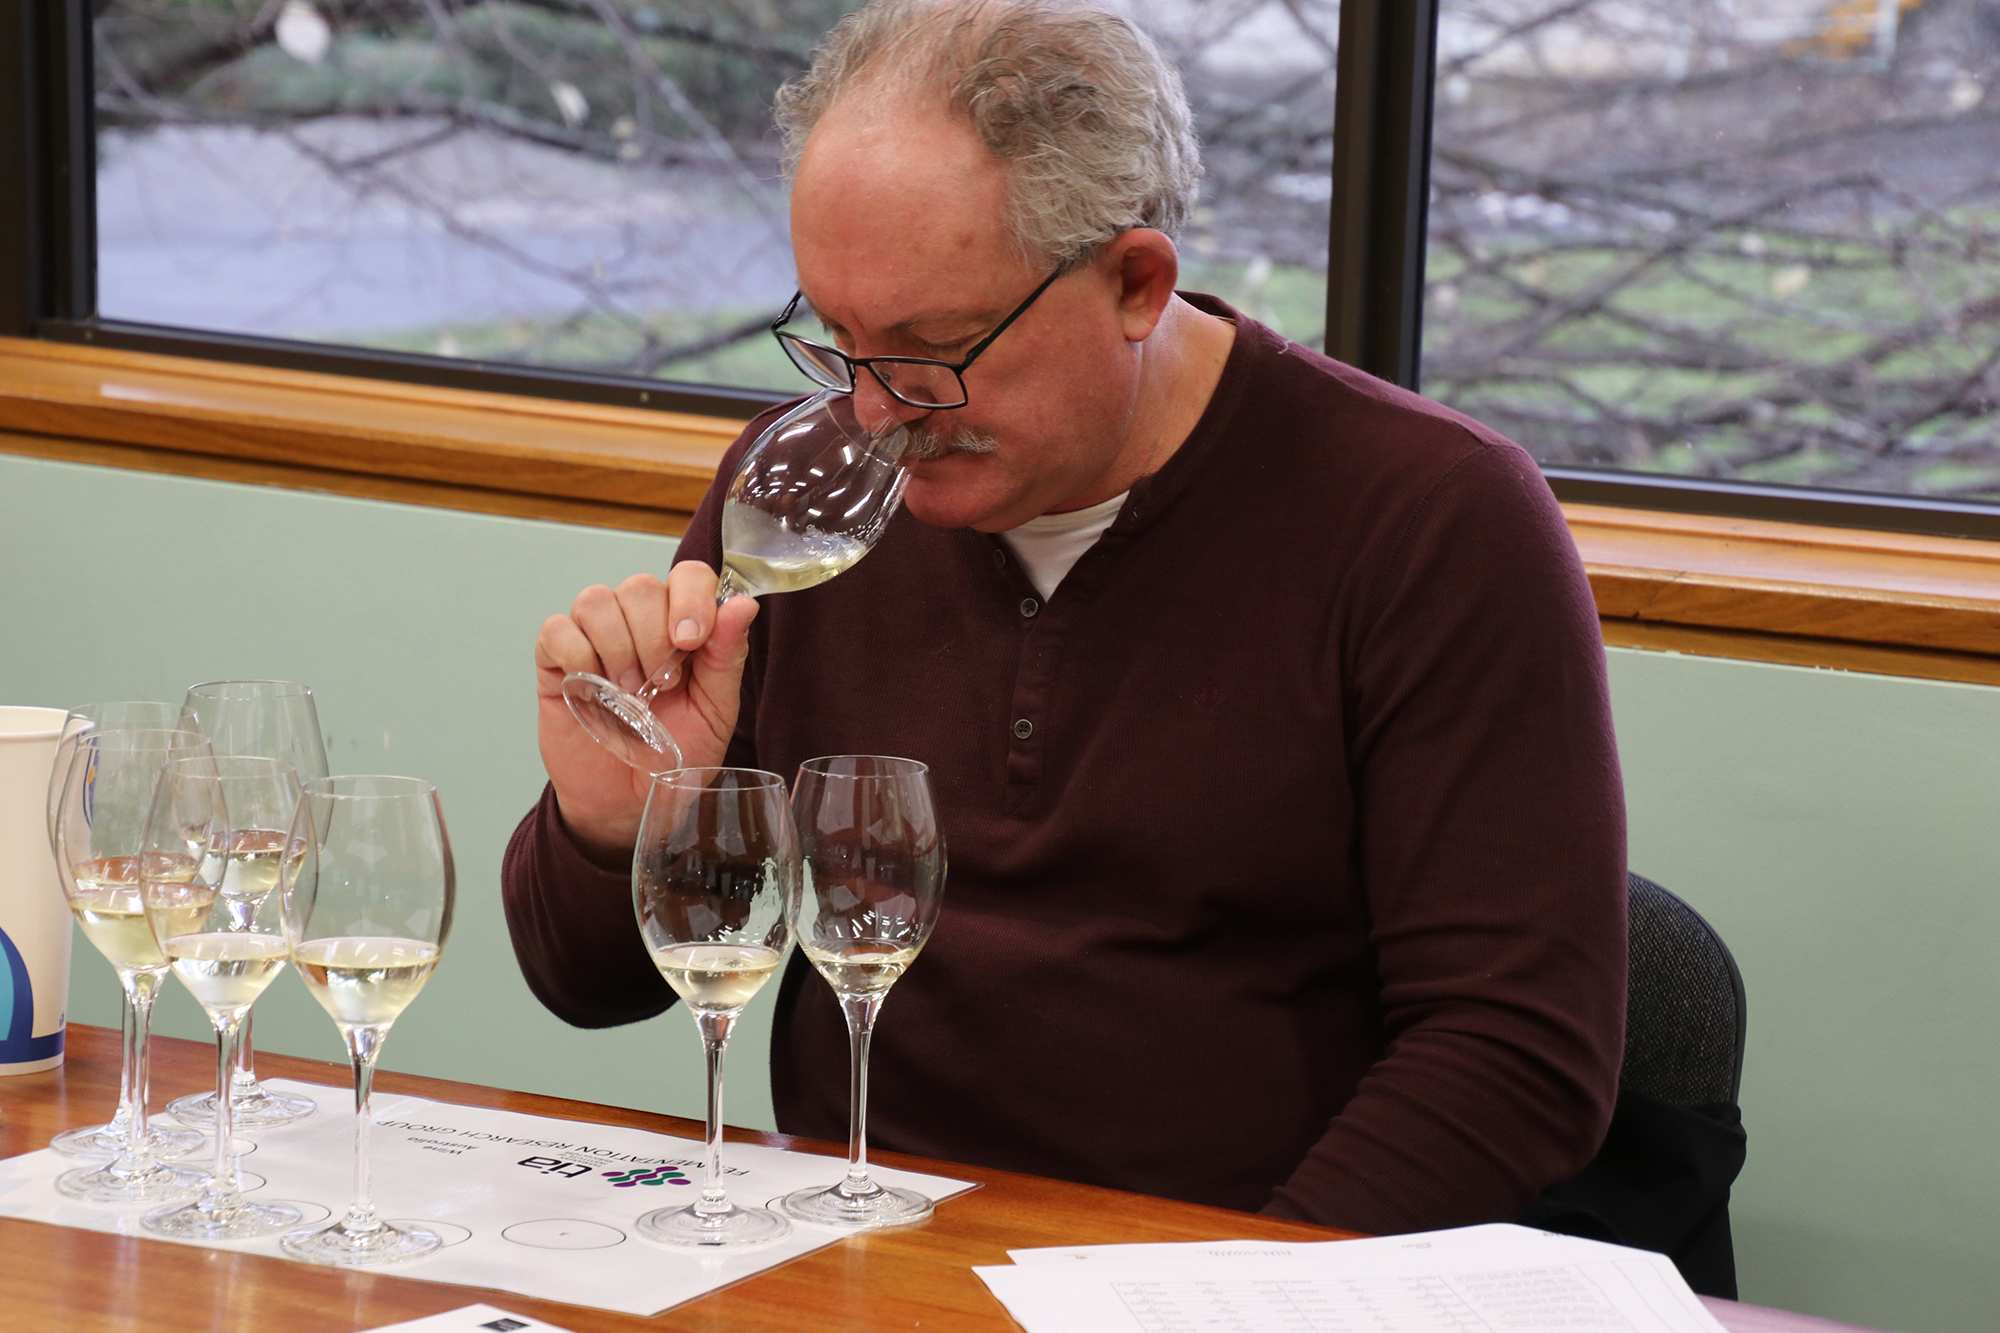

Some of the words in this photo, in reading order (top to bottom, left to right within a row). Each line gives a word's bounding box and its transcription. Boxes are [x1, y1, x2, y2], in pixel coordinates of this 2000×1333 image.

[376, 1120, 456, 1135] GROUP
[458, 1131, 573, 1150] RESEARCH
[517, 1155, 593, 1179] tia
[575, 1147, 750, 1177] FEMENTATION
